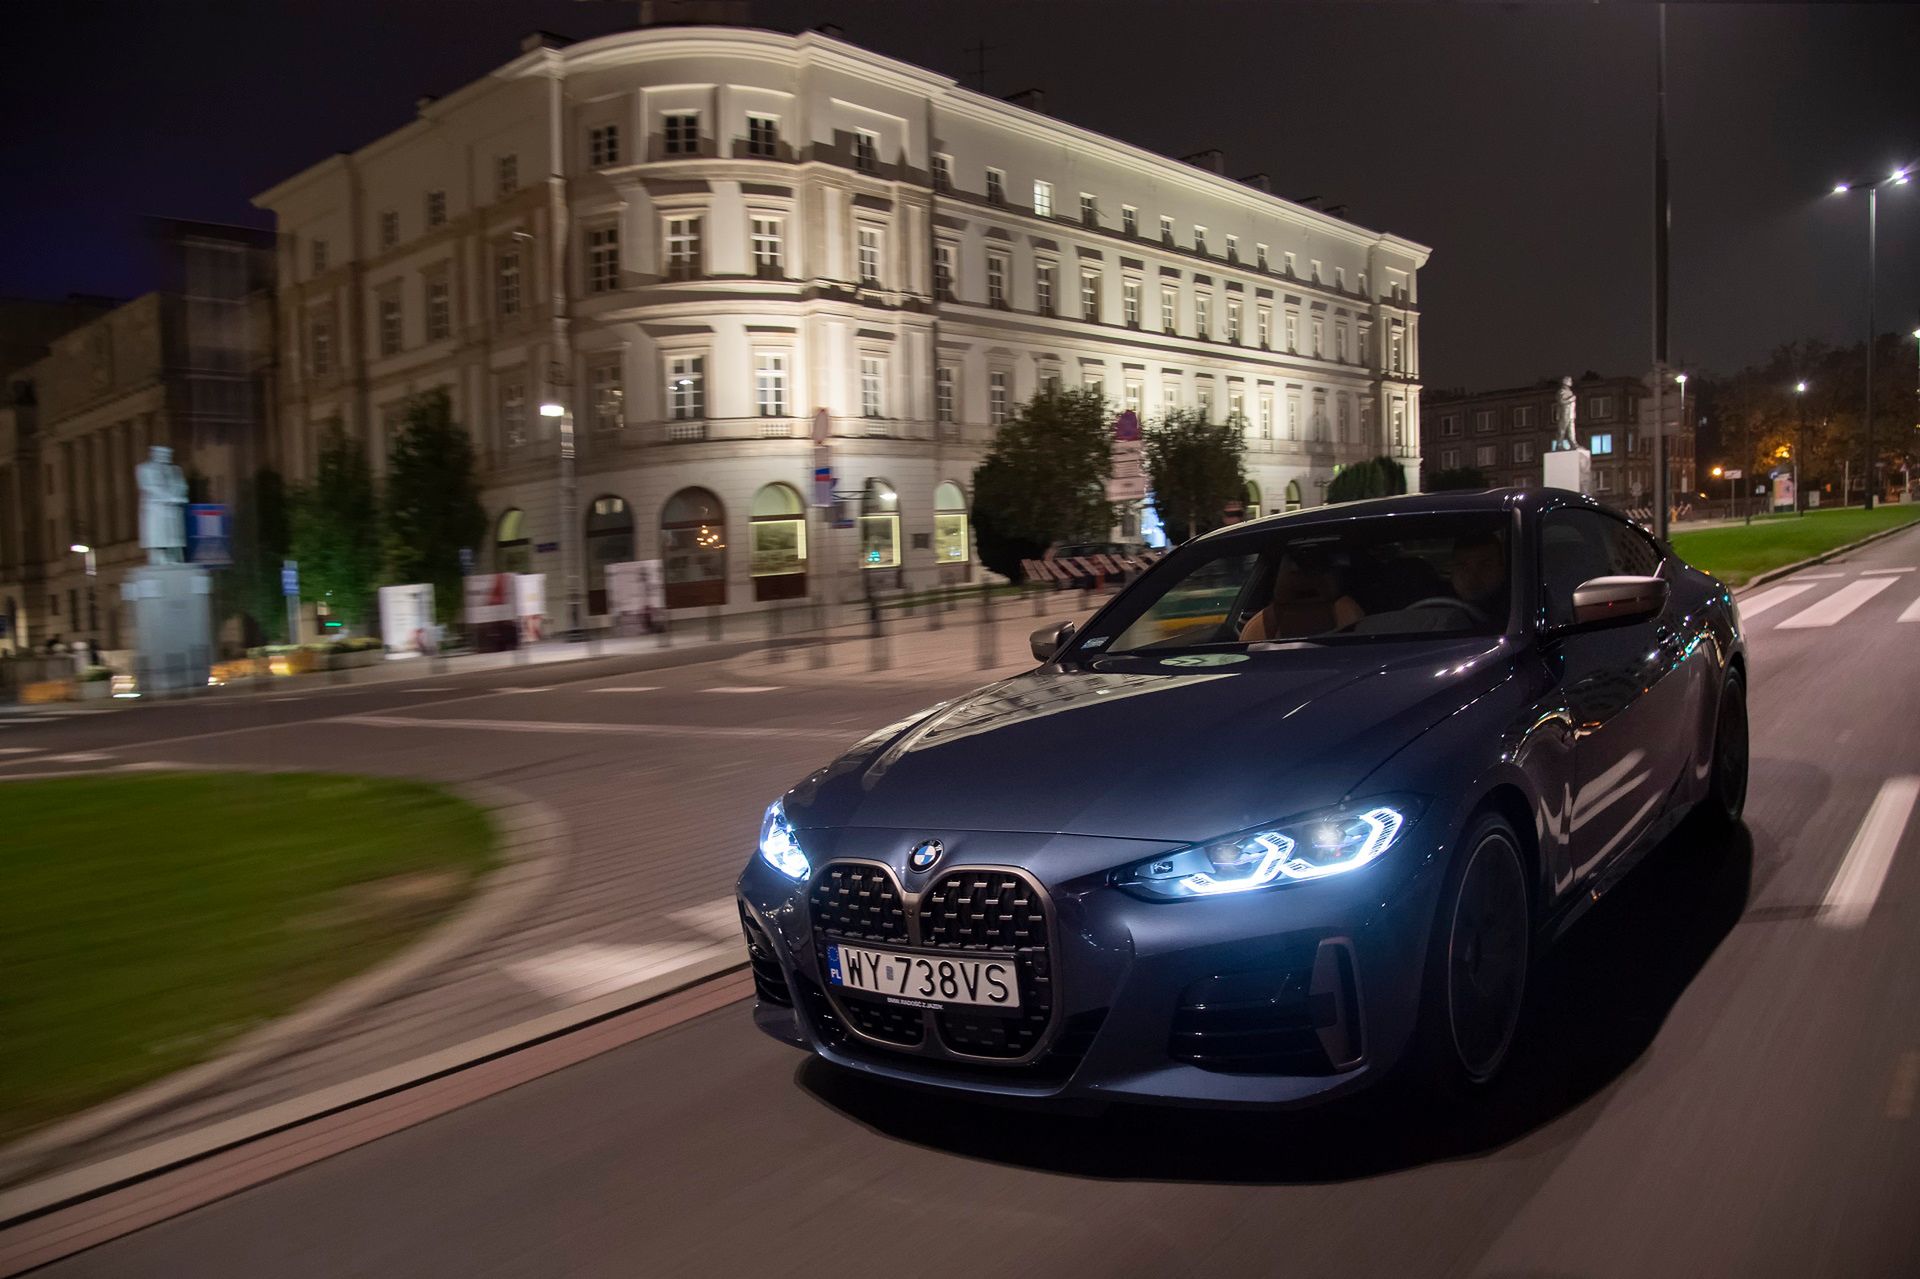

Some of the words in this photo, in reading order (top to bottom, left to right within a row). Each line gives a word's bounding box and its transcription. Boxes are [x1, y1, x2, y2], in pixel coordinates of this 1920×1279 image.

[830, 968, 841, 979] PL
[845, 949, 881, 990] WY
[894, 956, 1009, 1003] 738VS
